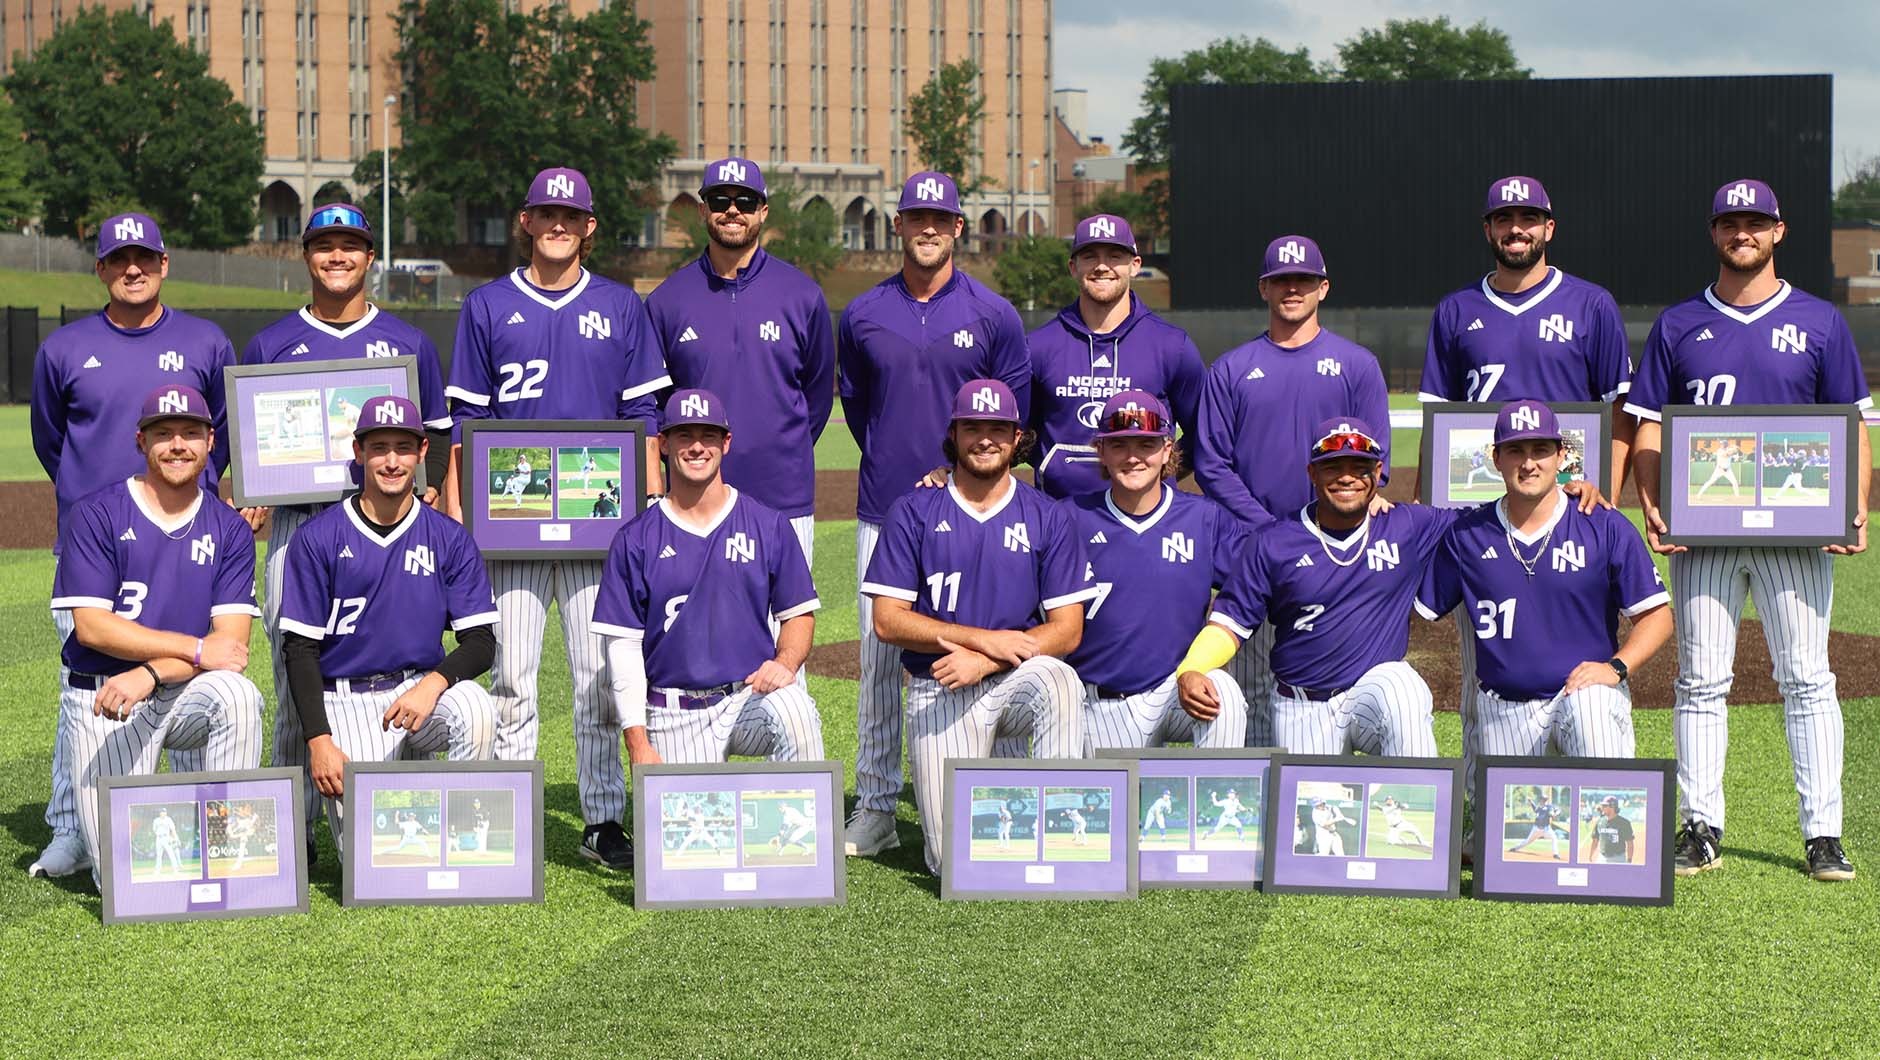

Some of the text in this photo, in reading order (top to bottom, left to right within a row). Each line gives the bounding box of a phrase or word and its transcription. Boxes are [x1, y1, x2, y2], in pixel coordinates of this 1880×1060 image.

[498, 359, 549, 403] 22
[1067, 375, 1131, 388] NORTH
[115, 581, 149, 620] 3
[926, 571, 962, 612] 11
[1085, 581, 1113, 620] 7
[326, 596, 367, 635] 12
[1293, 604, 1325, 632] 2
[1475, 598, 1517, 639] 31
